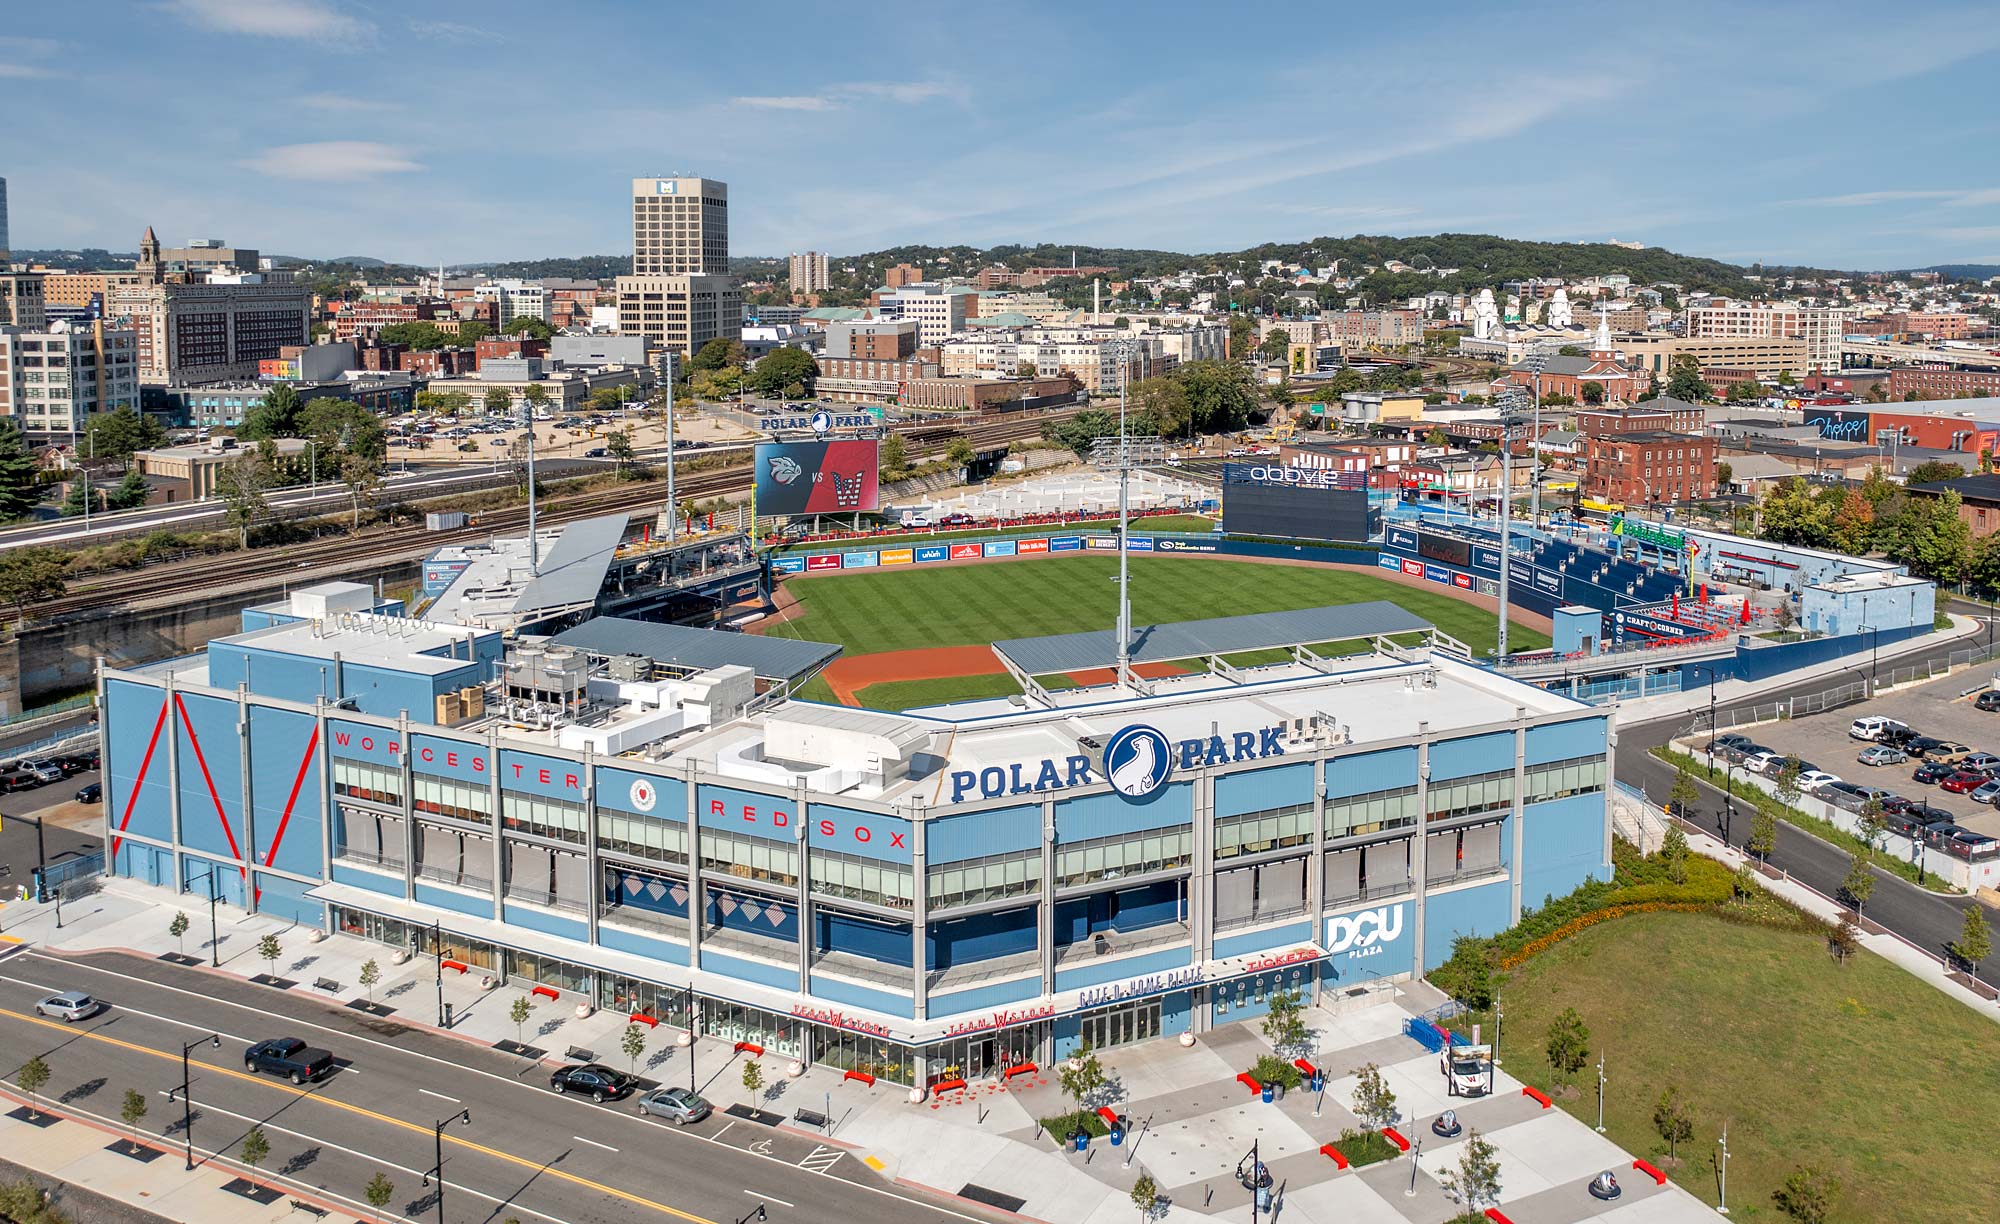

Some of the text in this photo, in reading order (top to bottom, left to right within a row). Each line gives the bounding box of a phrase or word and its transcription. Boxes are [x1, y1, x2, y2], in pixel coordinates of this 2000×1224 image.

[760, 414, 873, 430] POLAR PARK
[811, 472, 823, 483] VS
[1250, 463, 1339, 485] abbvie
[1456, 576, 1470, 586] Hood
[1626, 616, 1684, 636] CRAFT CORNER
[950, 726, 1285, 803] POLAR PARK
[335, 731, 905, 849] WORCESTER RED SOX
[1327, 904, 1404, 953] DCU
[1246, 948, 1319, 973] TICKETS
[1348, 945, 1383, 959] PLAZA
[1079, 986, 1108, 1008] GATE
[1130, 975, 1162, 997] HOME
[1168, 965, 1205, 988] PLATE
[793, 1003, 889, 1037] TEAM W STORE
[948, 1005, 1055, 1034] TEAM W STORE
